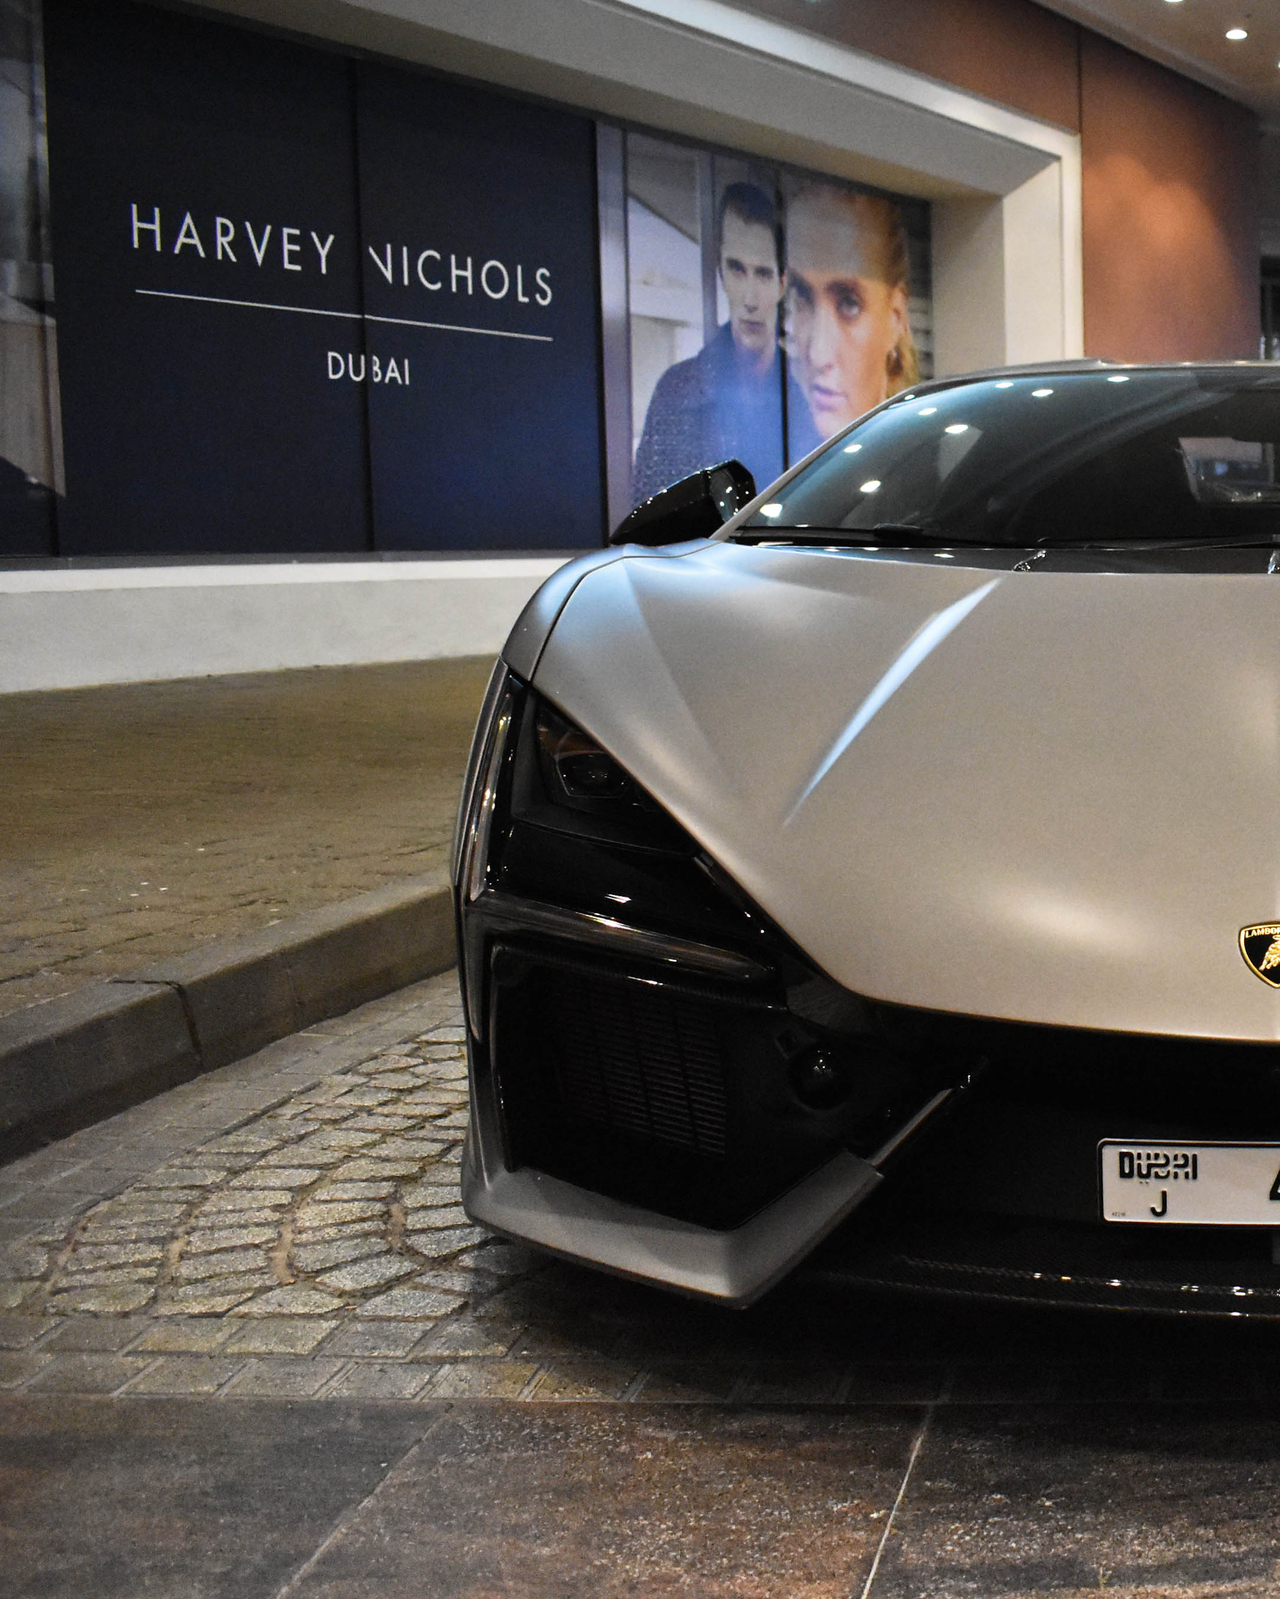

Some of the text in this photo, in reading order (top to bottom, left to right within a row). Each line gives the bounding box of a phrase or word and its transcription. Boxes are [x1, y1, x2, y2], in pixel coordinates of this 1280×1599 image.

[130, 202, 553, 307] HARVEY NICHOLS
[326, 351, 410, 386] DUBAI
[1150, 1190, 1168, 1218] J
